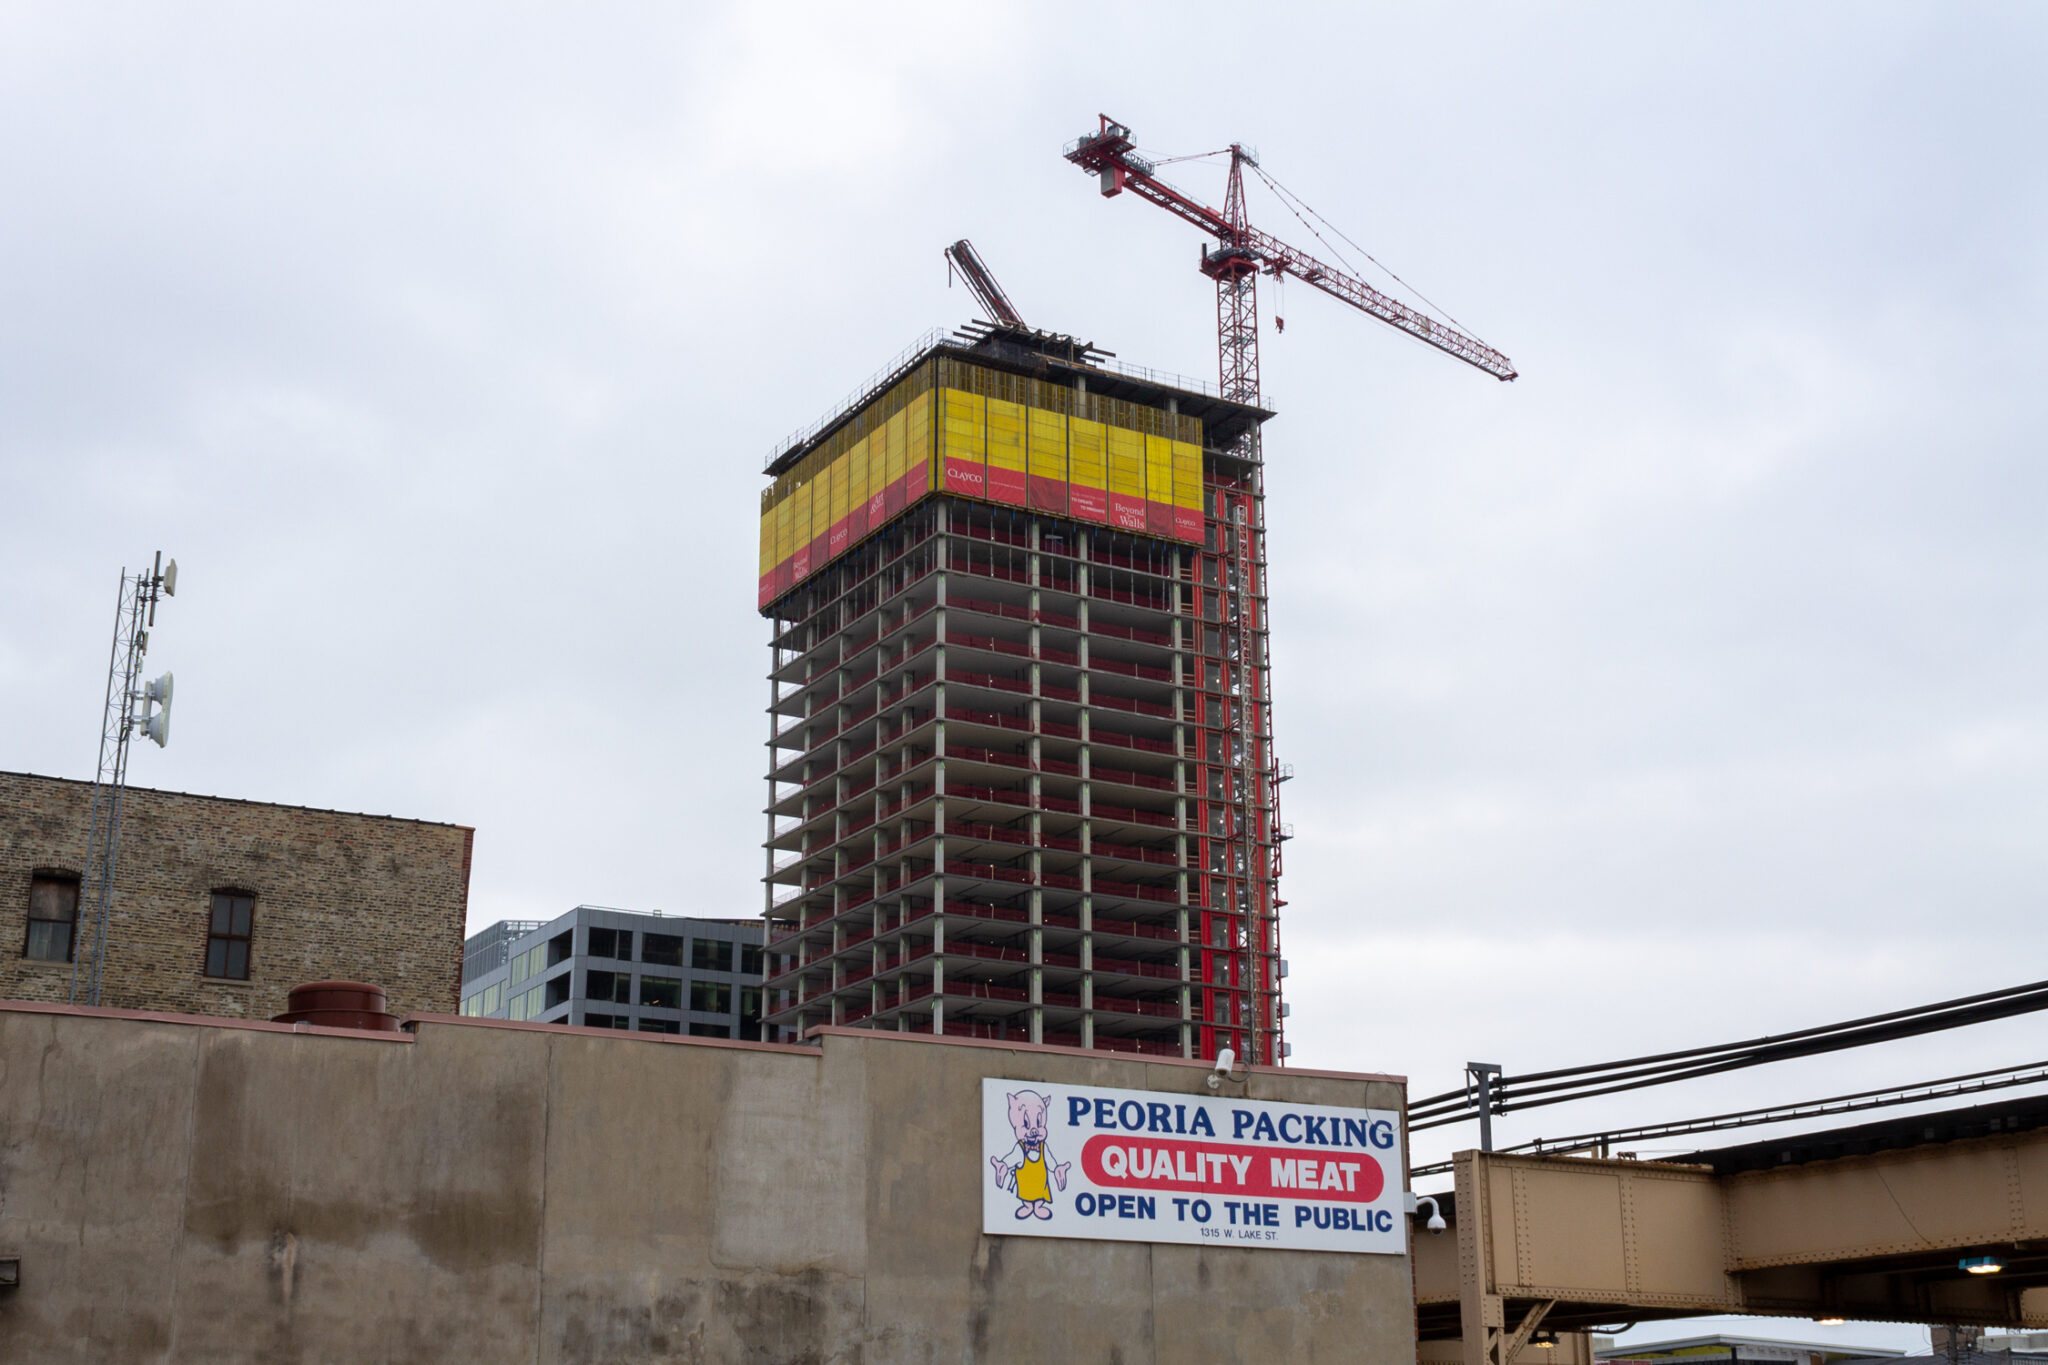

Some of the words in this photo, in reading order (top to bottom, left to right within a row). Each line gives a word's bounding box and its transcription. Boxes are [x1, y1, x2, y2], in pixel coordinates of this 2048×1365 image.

[947, 468, 983, 484] CLAYCO
[1115, 502, 1144, 517] Beyond
[1120, 515, 1145, 530] Walls
[1067, 1096, 1216, 1137] PEORIA
[1232, 1110, 1394, 1149] PACKING
[1101, 1146, 1252, 1184] QUALITY
[1270, 1158, 1361, 1192] MEAT
[1075, 1192, 1156, 1220] OPEN
[1172, 1198, 1212, 1222] TO
[1224, 1202, 1279, 1226] THE
[1295, 1206, 1393, 1233] PUBLIC
[1200, 1227, 1219, 1238] 1315
[1224, 1229, 1234, 1238] W.
[1238, 1230, 1262, 1239] LAKE
[1265, 1231, 1279, 1240] ST.
